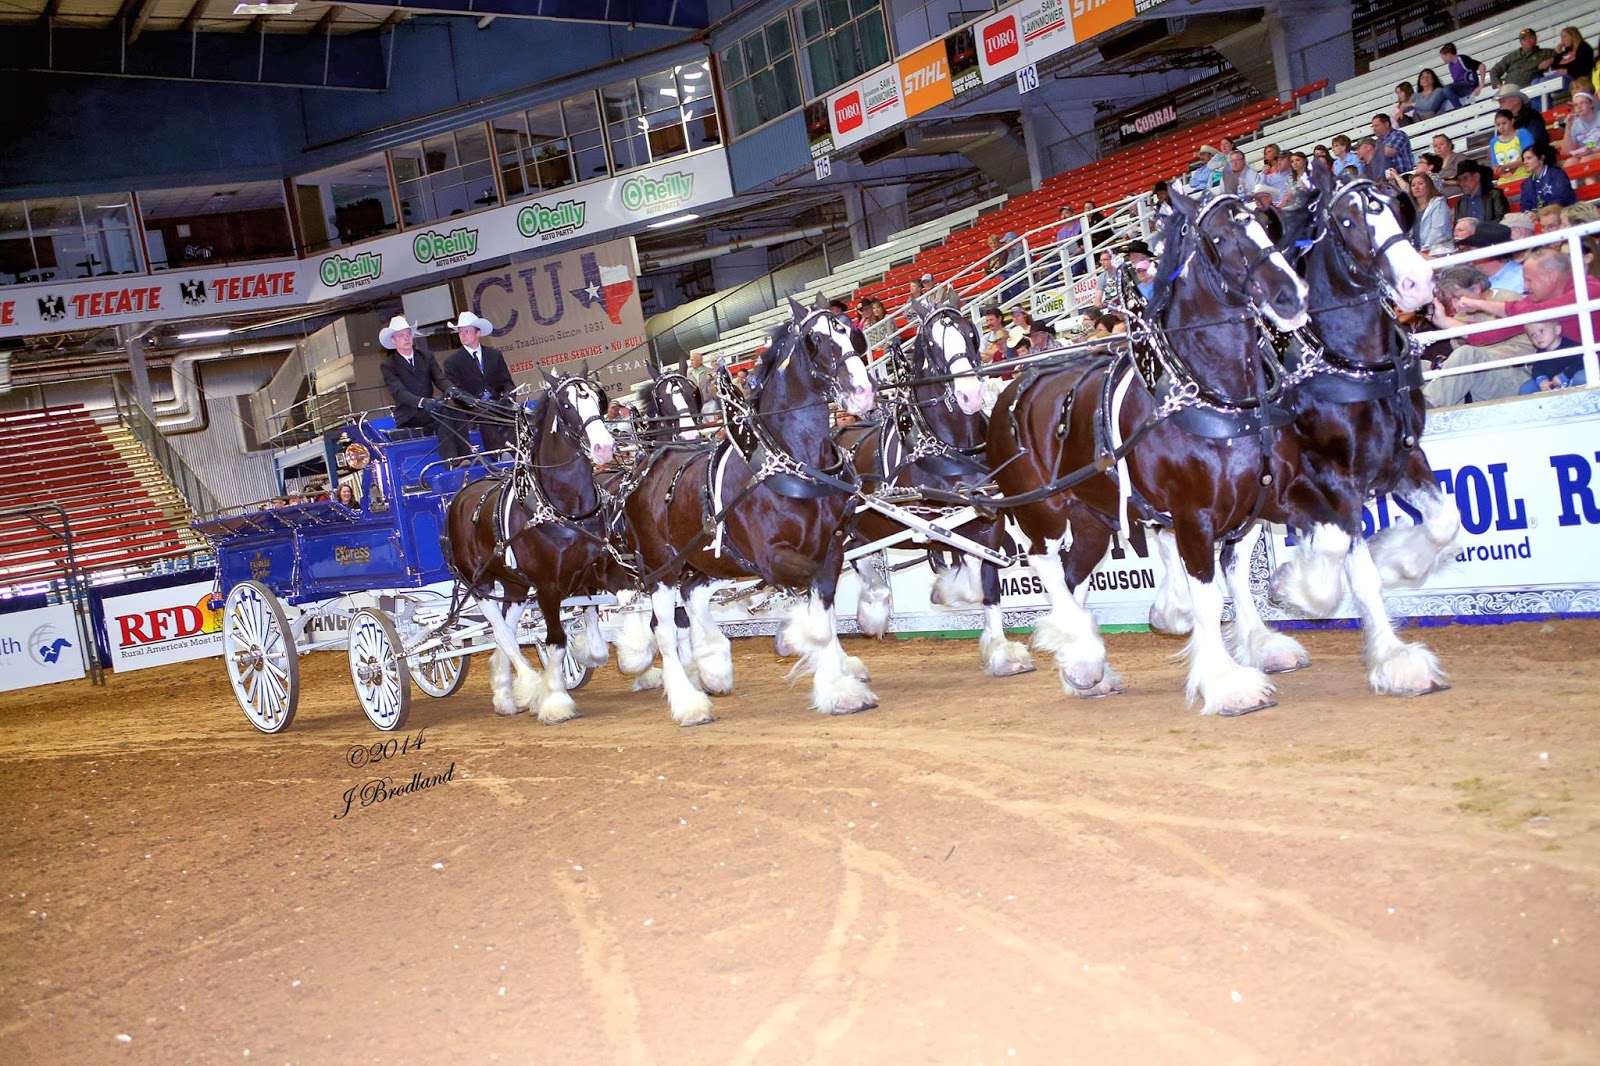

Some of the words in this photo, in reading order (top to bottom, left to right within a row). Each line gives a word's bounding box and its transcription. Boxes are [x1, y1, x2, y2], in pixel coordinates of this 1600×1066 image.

[1022, 8, 1064, 34] LAWNMOWER
[986, 29, 1015, 53] TORO
[904, 61, 946, 96] STIHL
[1019, 67, 1036, 91] 113
[836, 103, 860, 123] TORO
[1121, 123, 1136, 136] The
[1134, 106, 1177, 134] CORRAL
[816, 157, 831, 178] 115
[621, 171, 694, 211] O'Reilly
[517, 200, 586, 237] O'Reilly
[413, 227, 479, 263] O'Reilly
[541, 231, 555, 241] AUTO
[556, 228, 574, 238] PARTS
[319, 252, 383, 287] O'Reilly
[435, 258, 449, 268] AUTO
[449, 254, 467, 265] PARTS
[211, 271, 296, 301] TECATE
[342, 281, 354, 291] AUTO
[354, 278, 371, 288] PARTS
[72, 286, 162, 318] TECATE
[473, 261, 565, 338] CU
[1036, 294, 1050, 306] AG-
[515, 334, 556, 350] Tradition
[557, 328, 581, 341] Since
[584, 322, 605, 334] 1931
[509, 360, 534, 374] RATES
[541, 353, 571, 367] BETTER
[571, 345, 604, 361] SERVICE
[611, 341, 622, 352] NO
[607, 358, 650, 375] TEXAS
[1550, 451, 1600, 526] R
[1000, 575, 1048, 597] MASS
[1088, 568, 1155, 592] RGUSON
[115, 605, 204, 647] RFD
[121, 648, 144, 658] Rural
[146, 641, 188, 654] America's
[189, 636, 211, 646] Most
